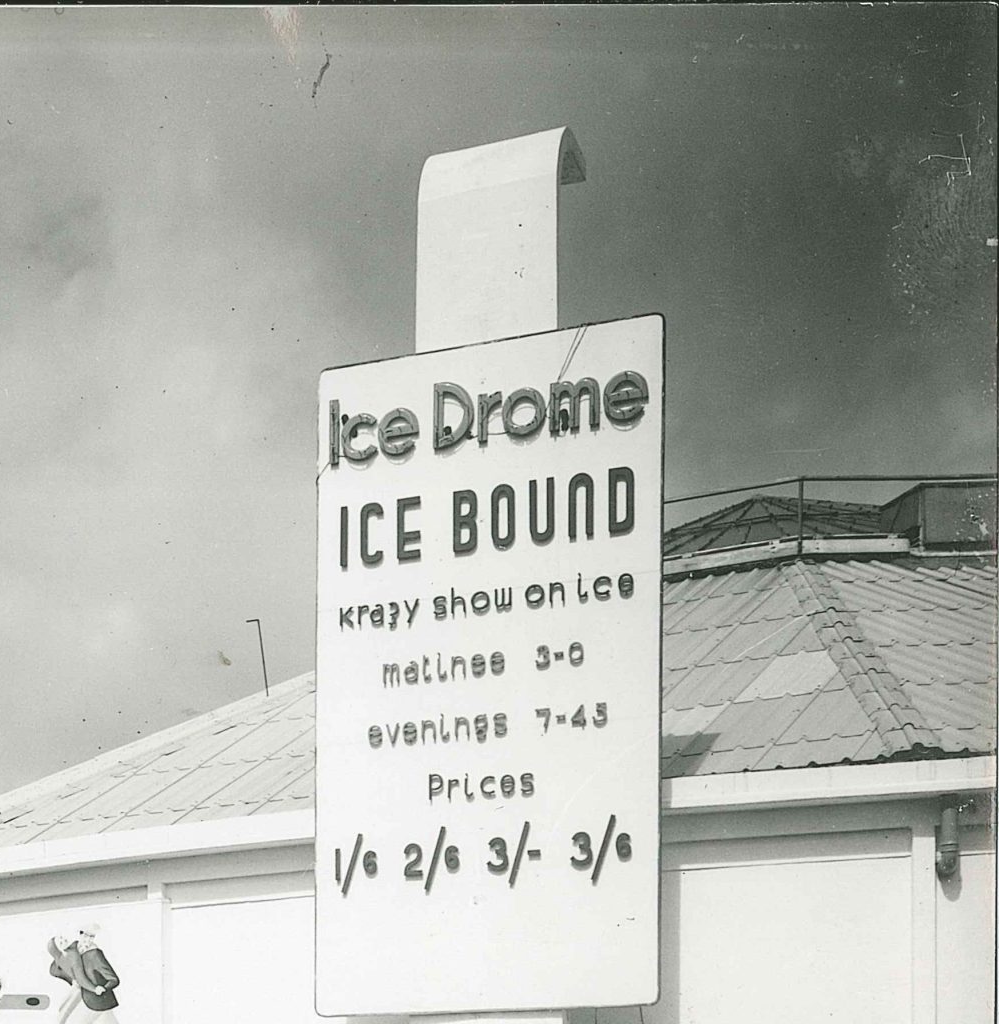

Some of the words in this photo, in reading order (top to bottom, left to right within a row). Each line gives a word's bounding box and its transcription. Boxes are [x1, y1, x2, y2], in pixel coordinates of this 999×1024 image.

[329, 399, 420, 466] Ice
[433, 370, 649, 451] Drome
[340, 496, 421, 571] ICE
[453, 466, 635, 556] BOUND
[433, 587, 513, 618] show
[524, 581, 565, 607] on
[577, 572, 634, 600] ice
[382, 651, 506, 688] matinee
[535, 641, 584, 671] 3-0
[367, 712, 508, 749] evenings
[535, 702, 608, 735] 7-45
[334, 833, 379, 897] 1/6
[403, 826, 461, 895] 2/6
[486, 821, 542, 888] 3/-
[570, 814, 633, 886] 3/6
